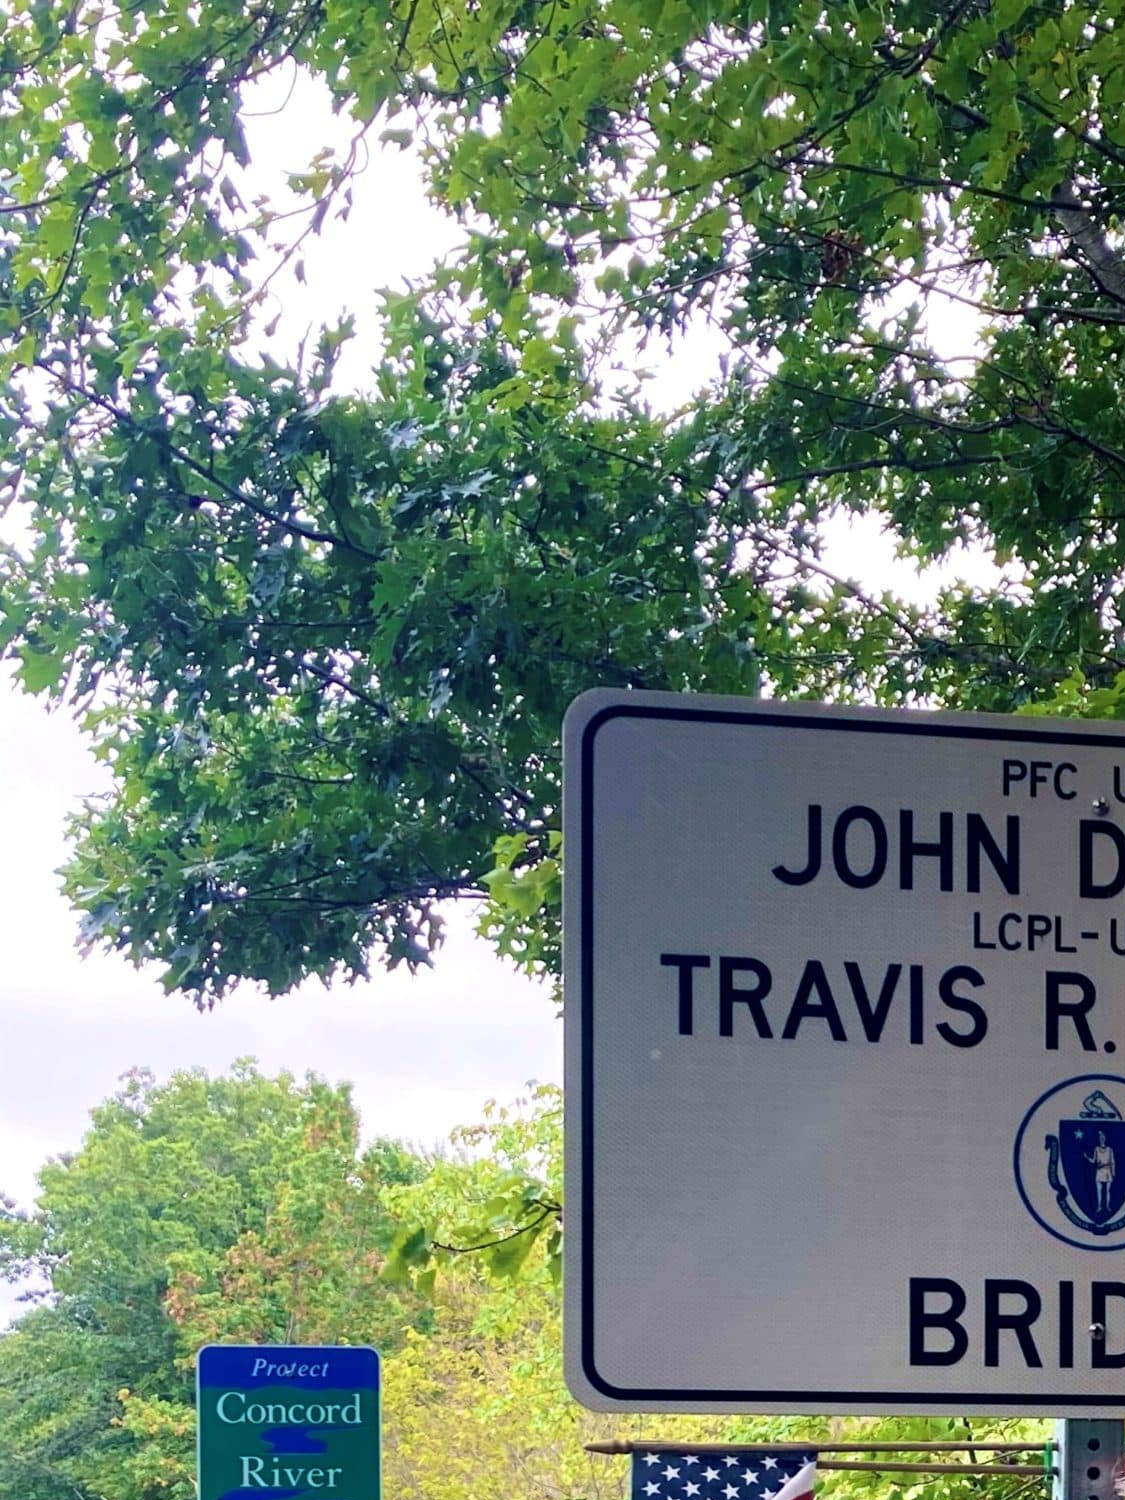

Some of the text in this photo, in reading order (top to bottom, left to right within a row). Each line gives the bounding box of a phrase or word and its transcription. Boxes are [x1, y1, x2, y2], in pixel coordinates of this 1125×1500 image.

[1002, 758, 1078, 800] PFC
[771, 804, 1020, 896] JOHN
[660, 953, 988, 1048] TRAVIS
[1046, 970, 1116, 1053] R.
[252, 1358, 329, 1377] Protect
[217, 1392, 362, 1424] Concord
[240, 1456, 342, 1487] River
